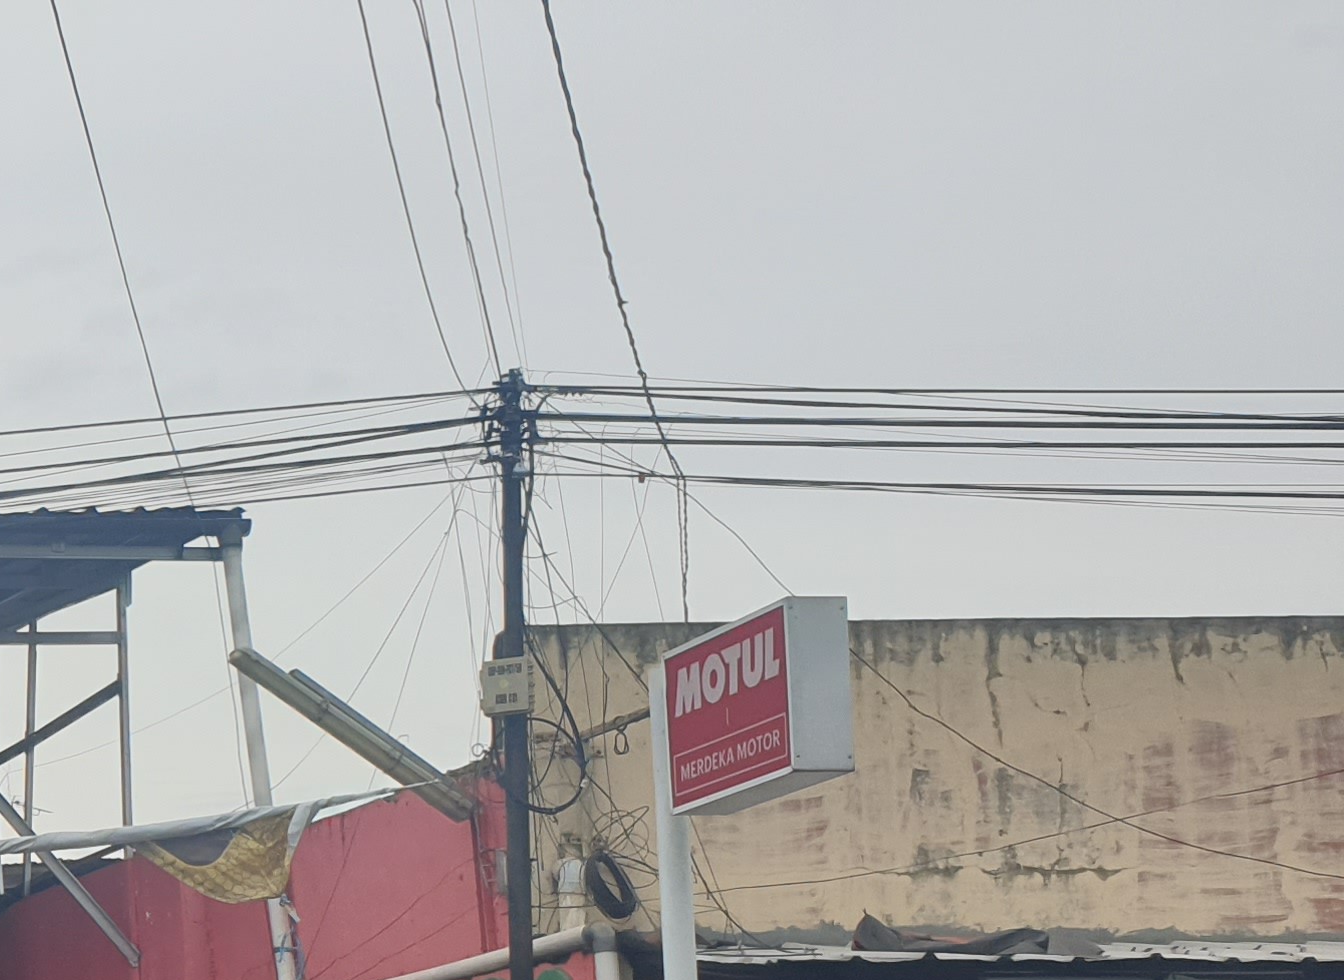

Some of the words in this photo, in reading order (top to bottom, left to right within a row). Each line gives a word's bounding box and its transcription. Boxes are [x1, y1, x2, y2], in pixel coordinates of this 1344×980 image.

[674, 627, 780, 718] MOTUL
[680, 747, 735, 782] MERDEKA
[737, 728, 781, 760] MOTOR
